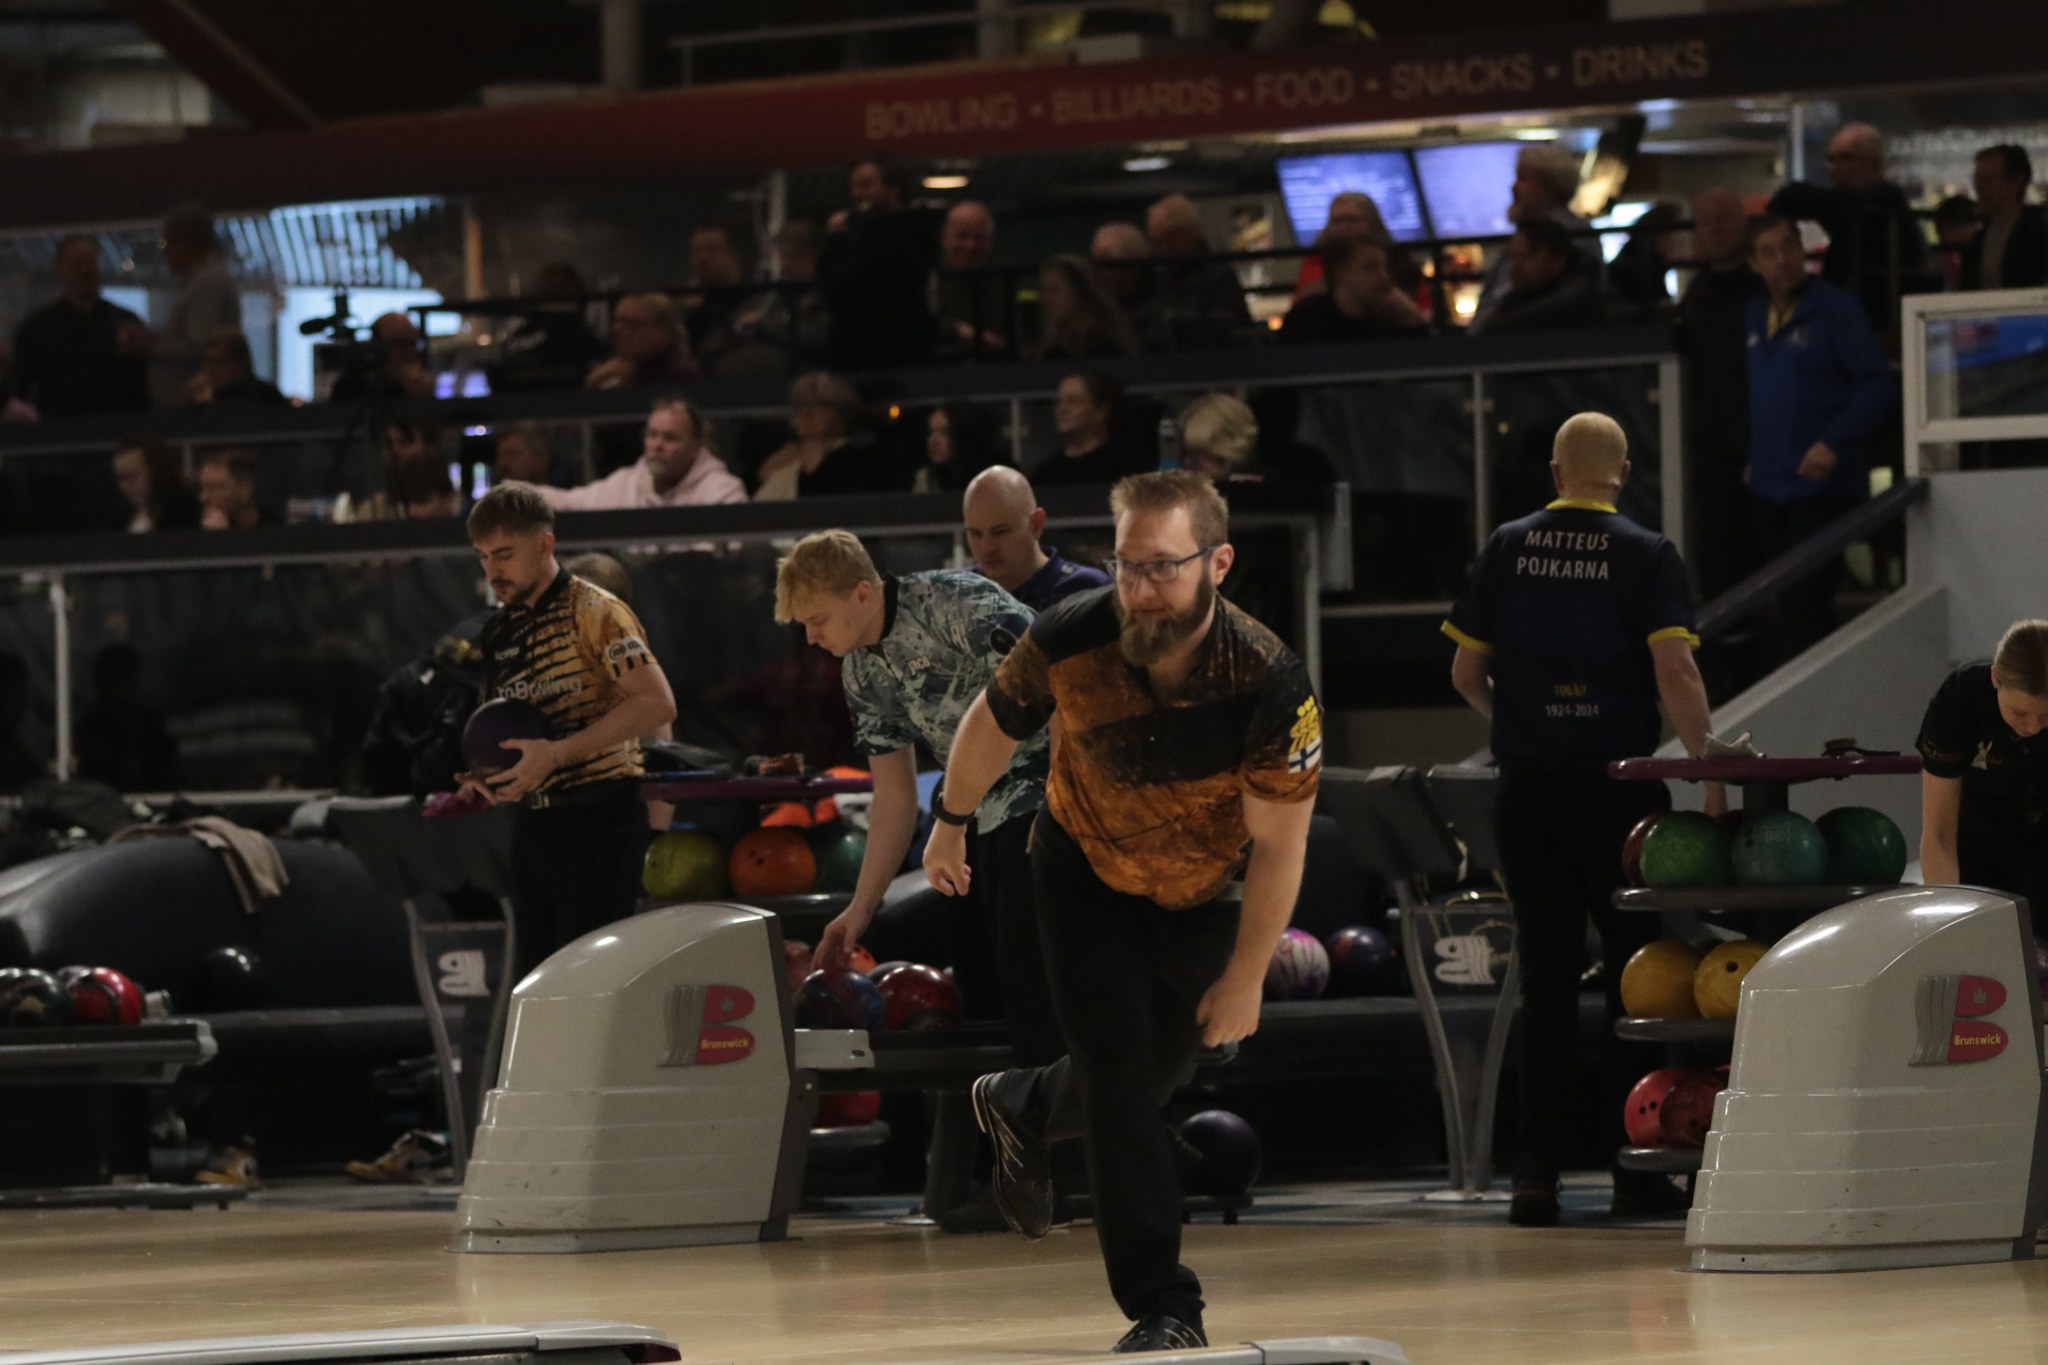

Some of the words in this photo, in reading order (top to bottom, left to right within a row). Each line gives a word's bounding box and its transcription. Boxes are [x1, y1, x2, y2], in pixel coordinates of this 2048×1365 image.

[866, 93, 1018, 141] BOWLING
[1051, 78, 1223, 126] BILLIARDS
[1254, 67, 1354, 108] FOOD
[1391, 53, 1536, 99] SNACKS
[1571, 40, 1709, 88] DRINKS
[1524, 529, 1610, 552] MATTEUS
[1516, 555, 1609, 581] POJKARNA
[700, 1038, 749, 1050] Brunswick
[1953, 1034, 2002, 1047] Brunswick
